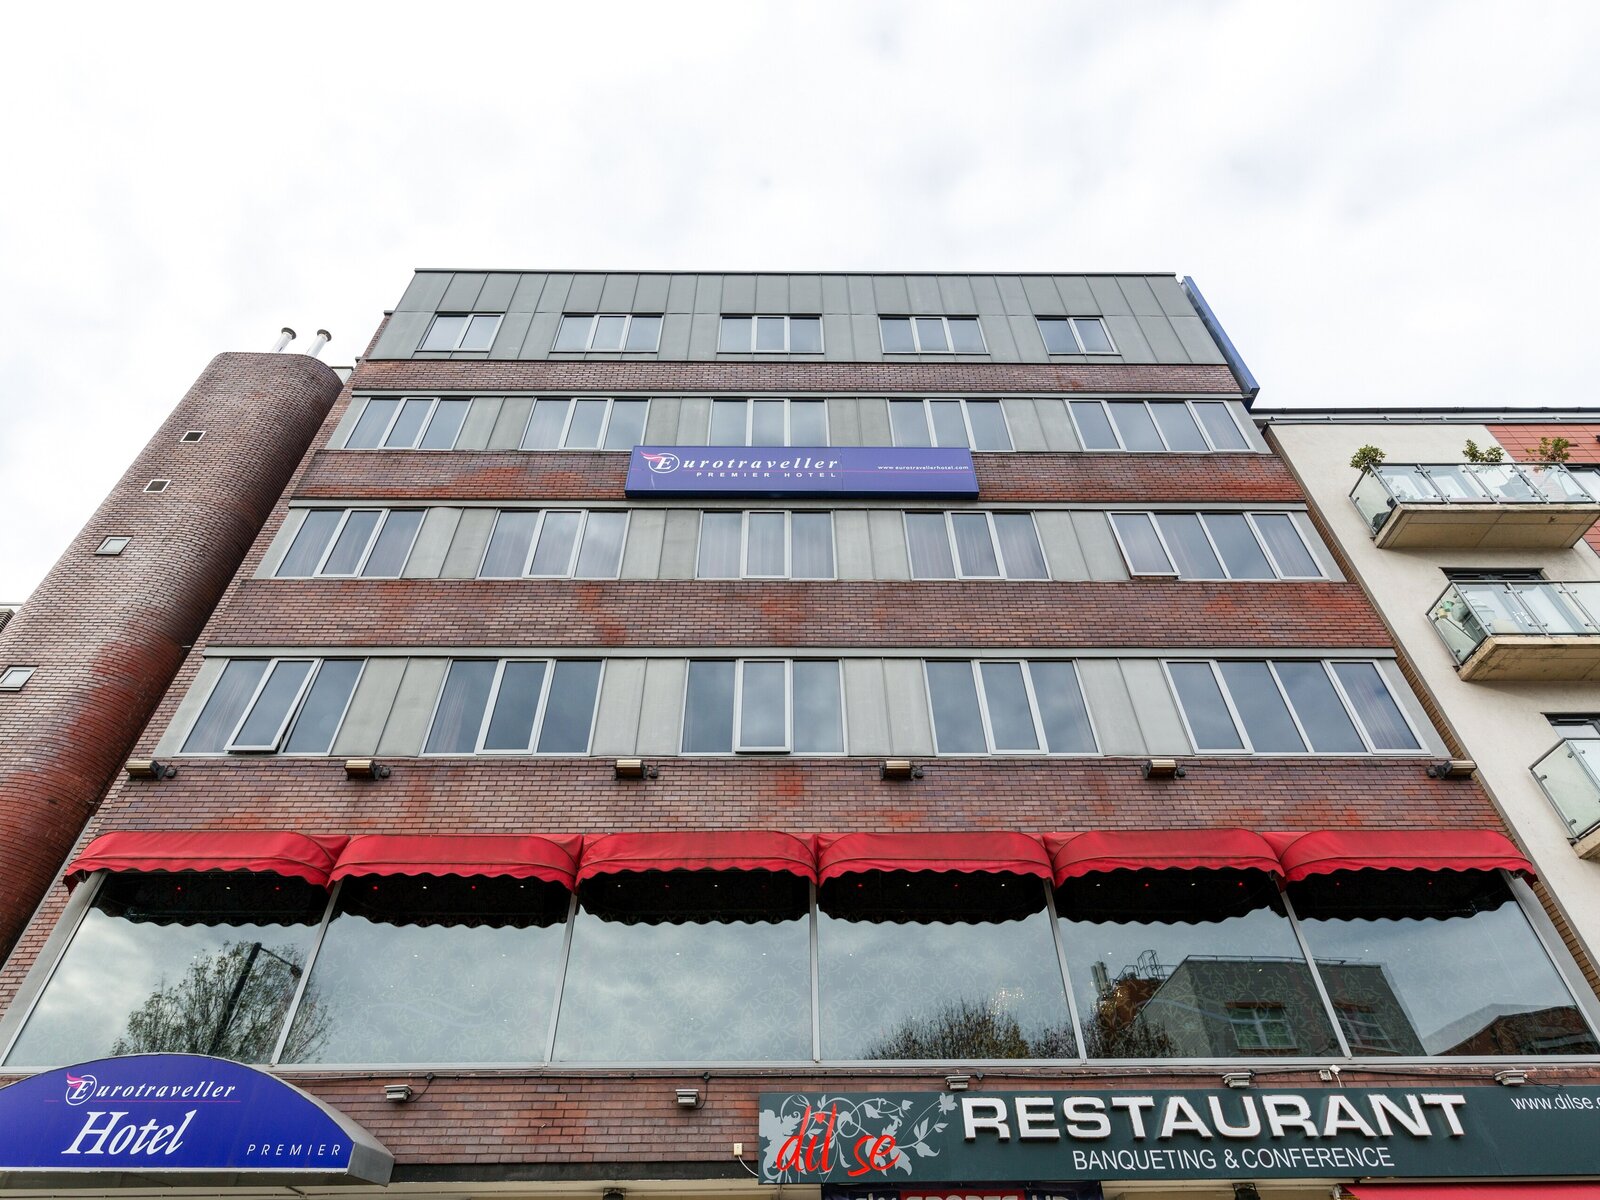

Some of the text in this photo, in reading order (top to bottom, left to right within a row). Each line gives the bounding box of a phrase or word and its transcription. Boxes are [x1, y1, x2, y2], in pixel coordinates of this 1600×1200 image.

[656, 455, 839, 471] Eurotraveller
[70, 1077, 237, 1102] Eurotraveller
[961, 1094, 1467, 1141] RESTAURANT
[61, 1109, 198, 1157] Hotel
[776, 1102, 901, 1177] dil se
[246, 1143, 342, 1157] PREMIER
[1072, 1146, 1395, 1172] BANQUETING & CONFERENCE
